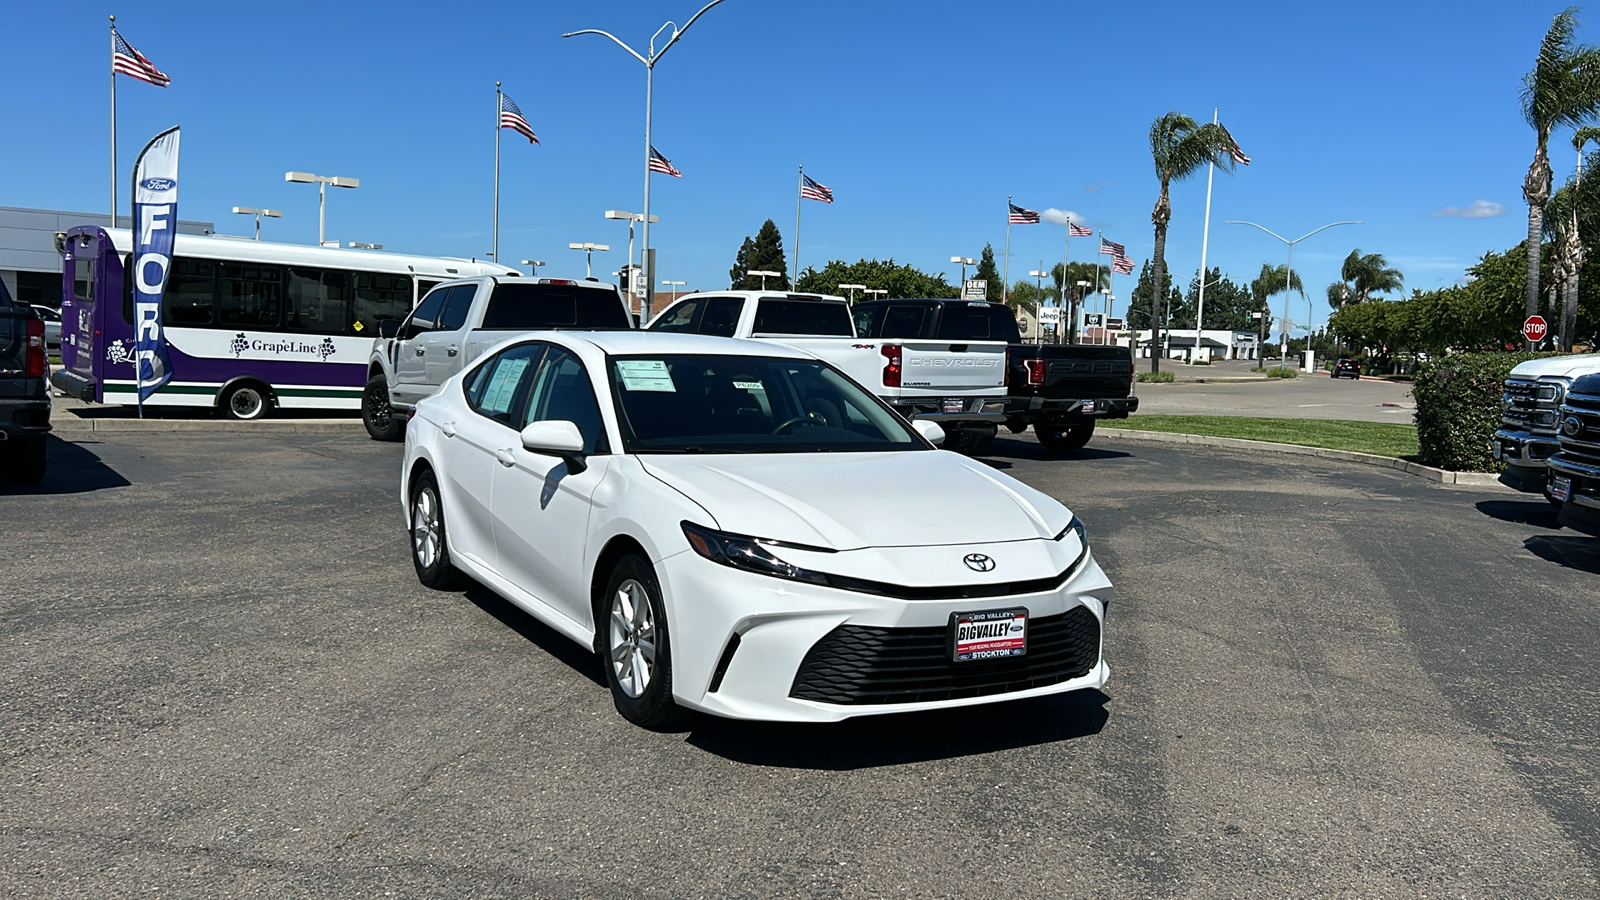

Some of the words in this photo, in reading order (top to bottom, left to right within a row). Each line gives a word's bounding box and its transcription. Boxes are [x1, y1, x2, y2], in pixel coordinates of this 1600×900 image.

[147, 180, 171, 190] Ford
[966, 281, 985, 289] OEM
[135, 205, 170, 388] FORD
[1040, 312, 1059, 321] Jeep
[1525, 323, 1545, 334] STOP
[251, 340, 317, 354] GrapeLine
[909, 357, 1001, 368] CHEVROLET
[958, 622, 1011, 641] BIGVALLEY
[972, 649, 1010, 659] STOCKTON
